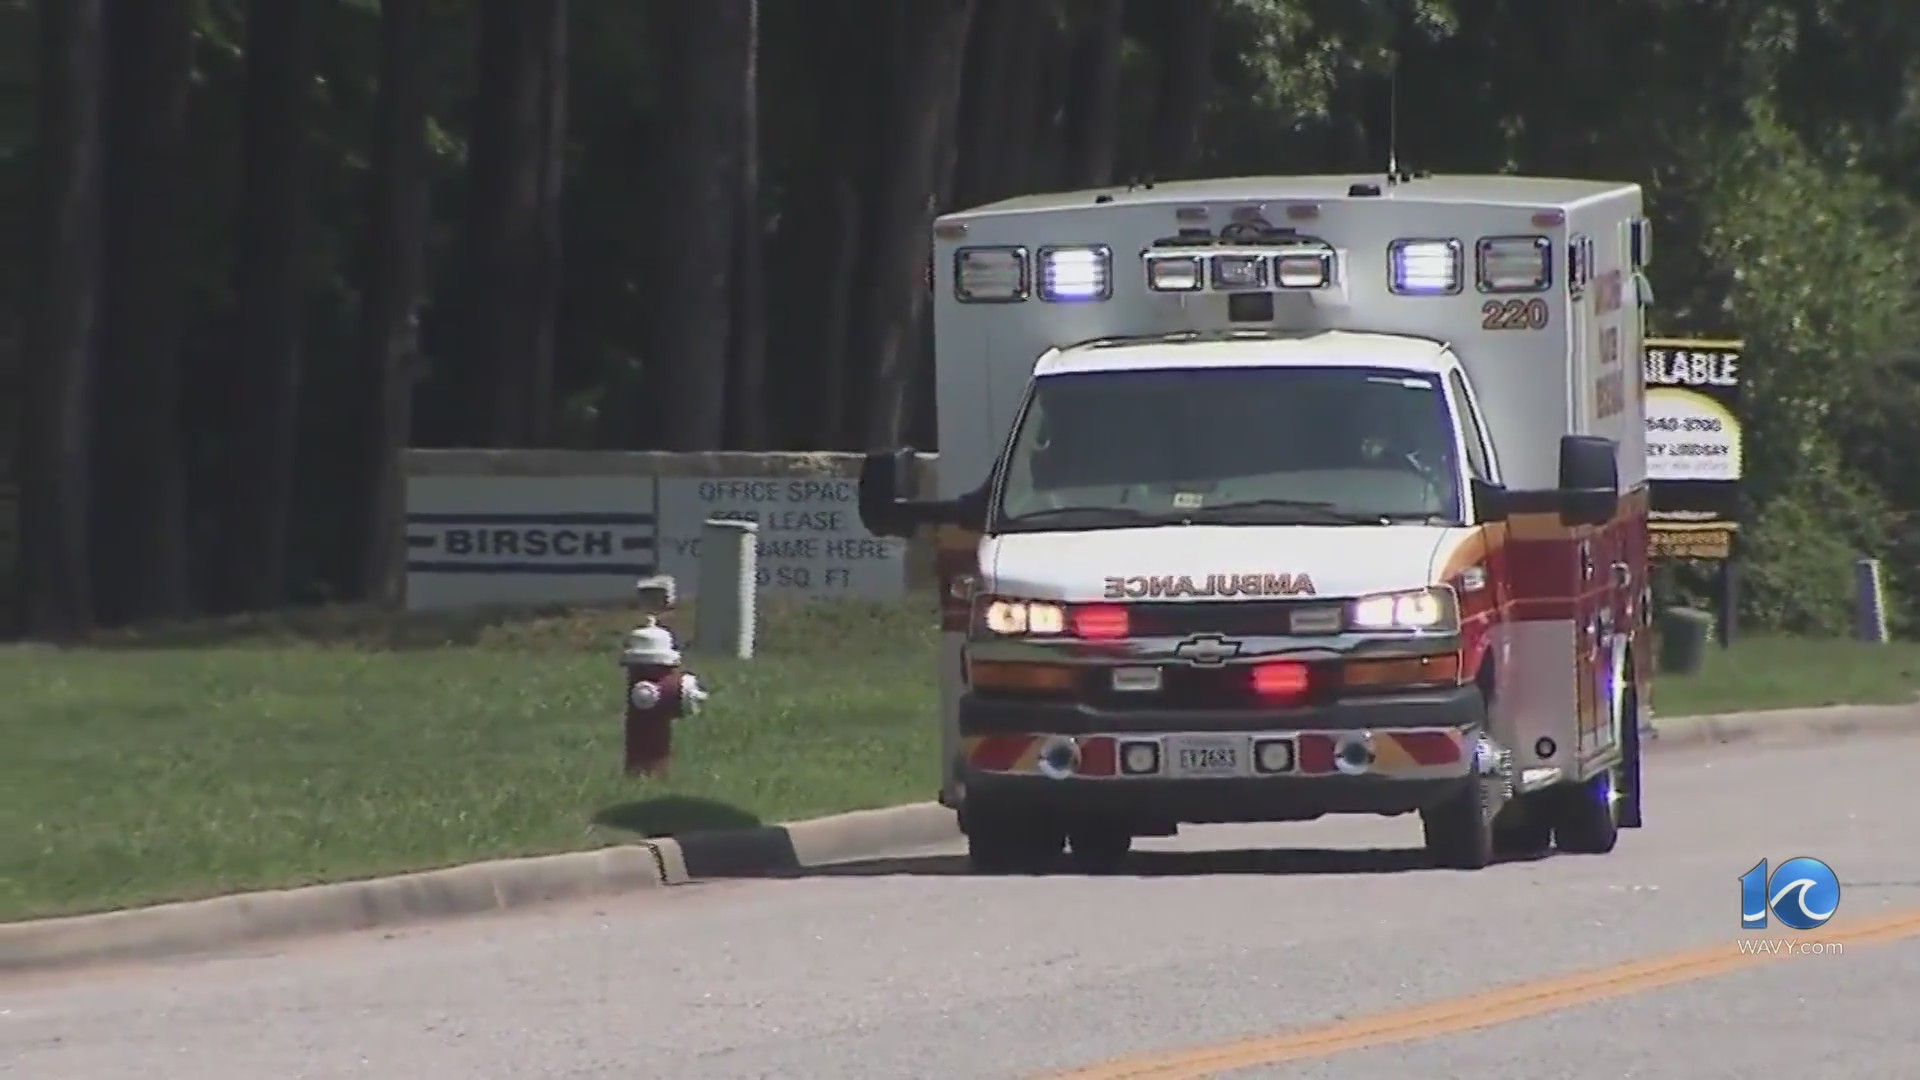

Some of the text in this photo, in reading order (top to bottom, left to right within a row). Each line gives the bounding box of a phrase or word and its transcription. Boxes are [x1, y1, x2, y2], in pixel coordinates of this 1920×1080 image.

[1482, 299, 1549, 330] 220
[699, 481, 780, 502] OFFICE
[769, 511, 846, 531] LEASE
[444, 529, 613, 556] BIRSCH
[826, 538, 891, 560] HERE
